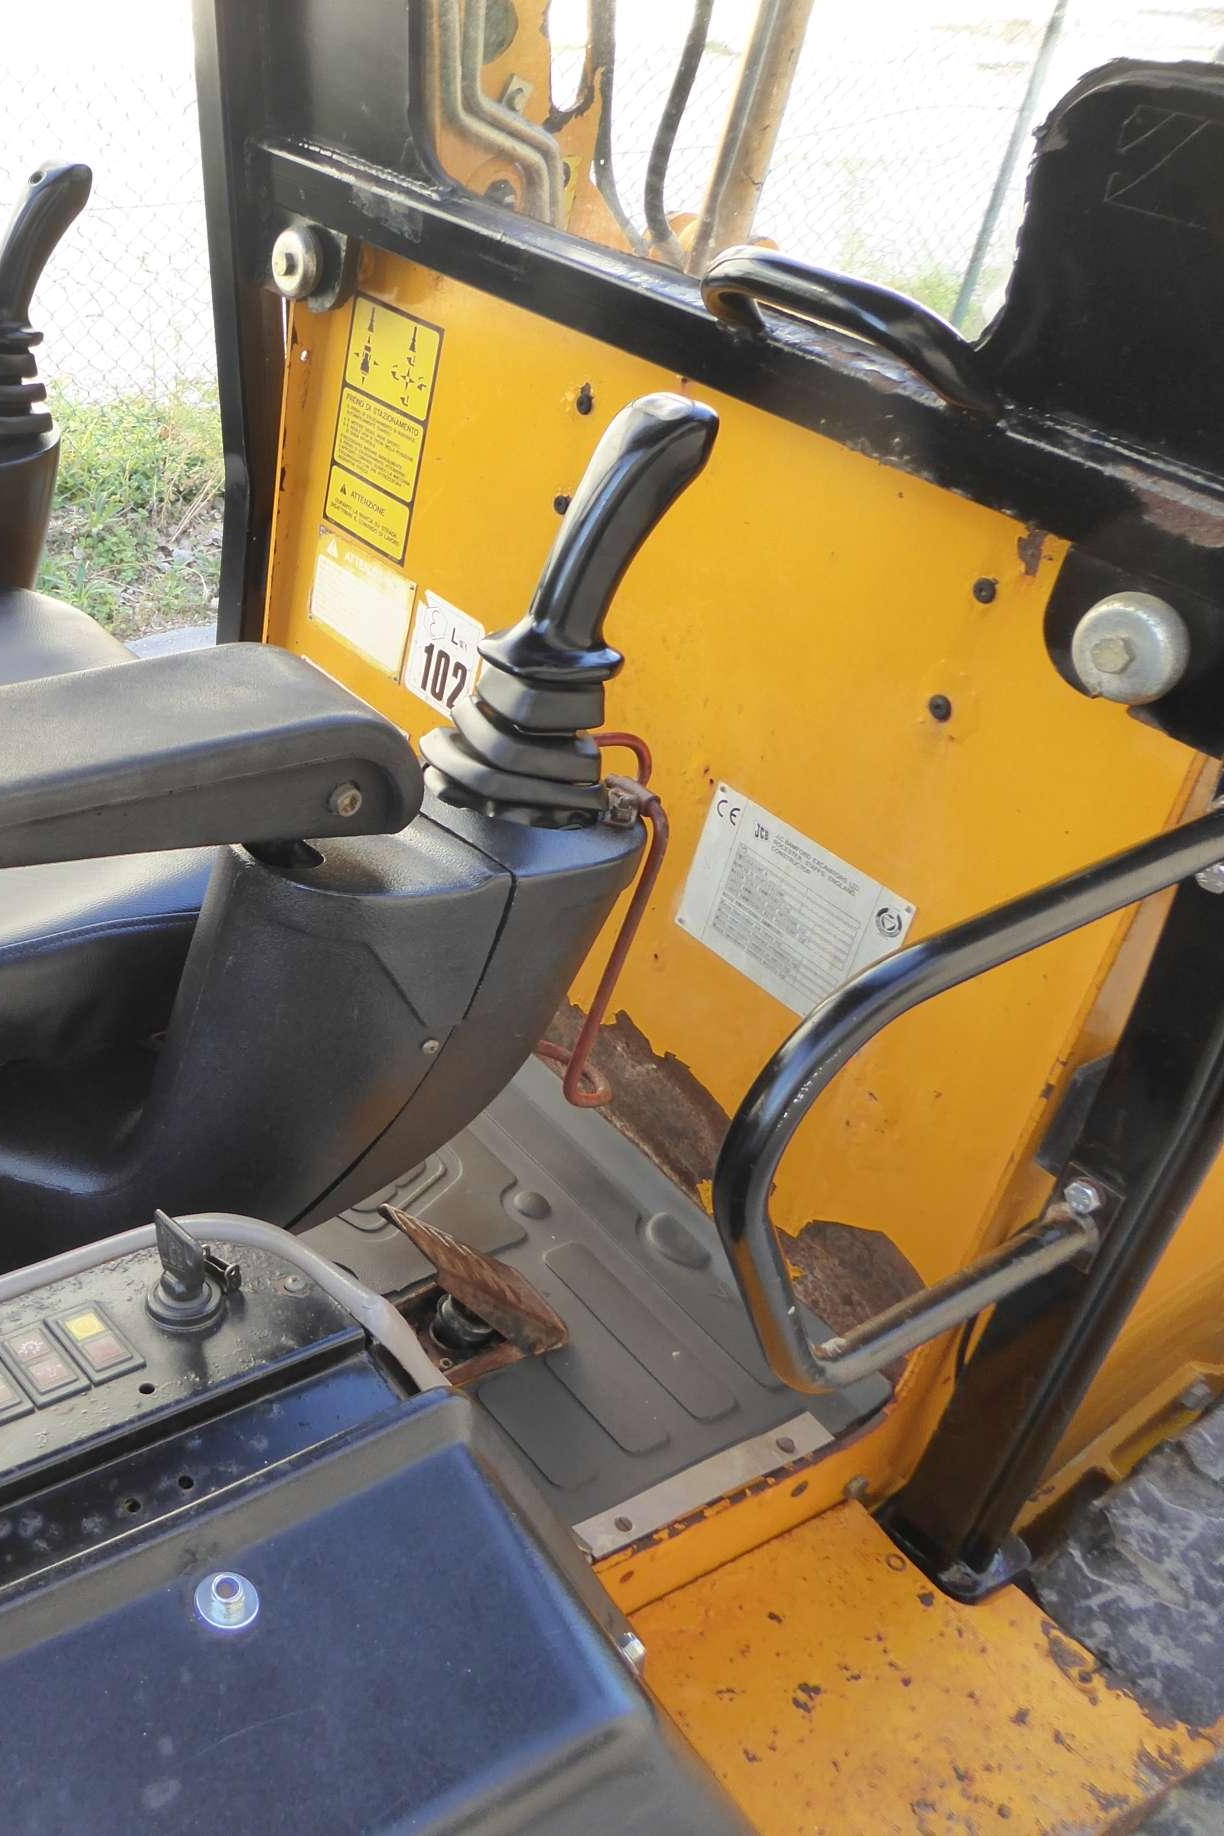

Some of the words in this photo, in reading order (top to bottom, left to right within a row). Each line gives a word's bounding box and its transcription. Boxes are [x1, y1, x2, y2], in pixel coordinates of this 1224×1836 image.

[351, 491, 385, 517] ATTENZIONE
[420, 643, 468, 709] 102
[717, 800, 741, 826] CE
[755, 823, 769, 840] JCB
